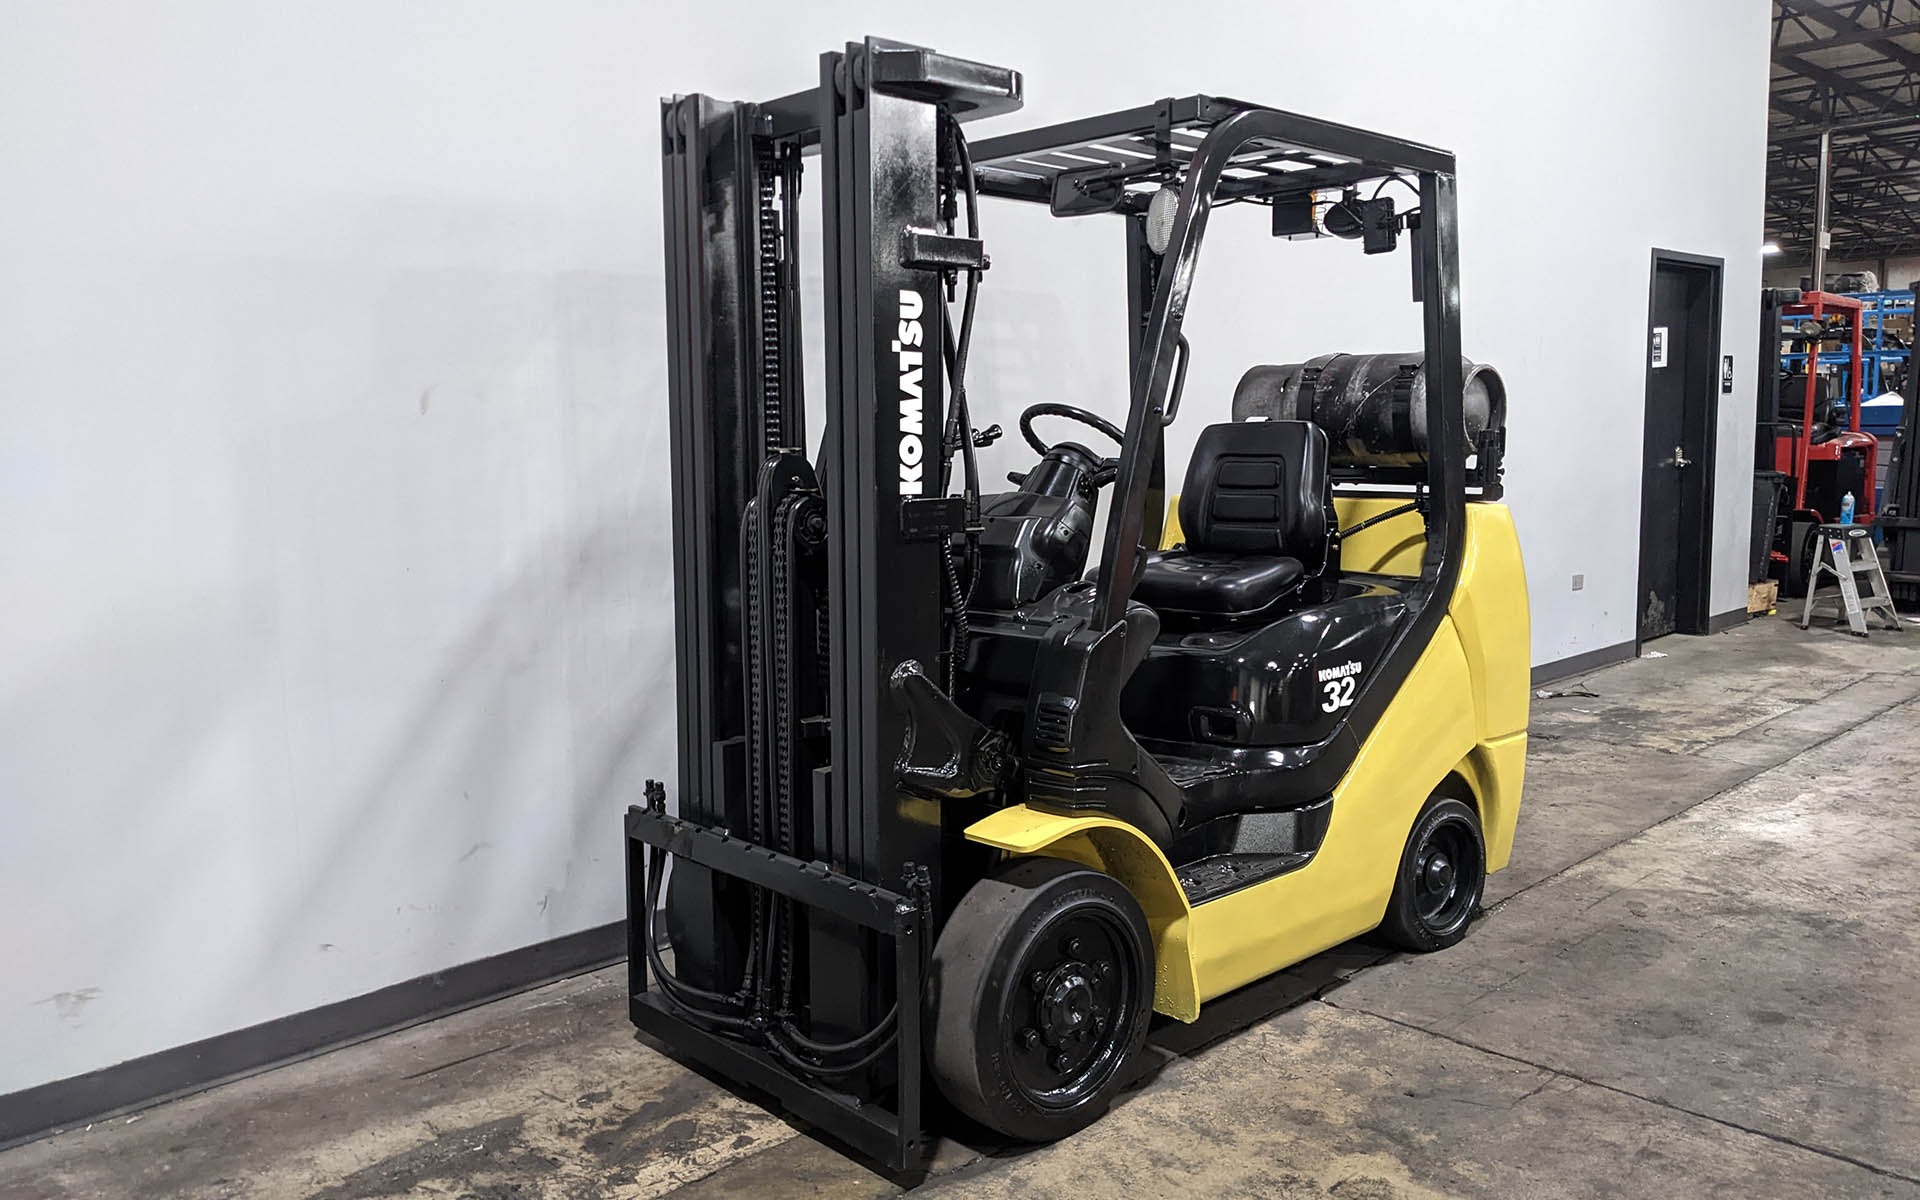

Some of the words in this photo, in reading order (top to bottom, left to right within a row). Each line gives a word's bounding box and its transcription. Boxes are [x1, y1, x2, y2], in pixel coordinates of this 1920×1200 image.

[891, 289, 924, 495] KOMATSU
[1317, 660, 1362, 683] KOMATSU
[1321, 676, 1356, 713] 32
